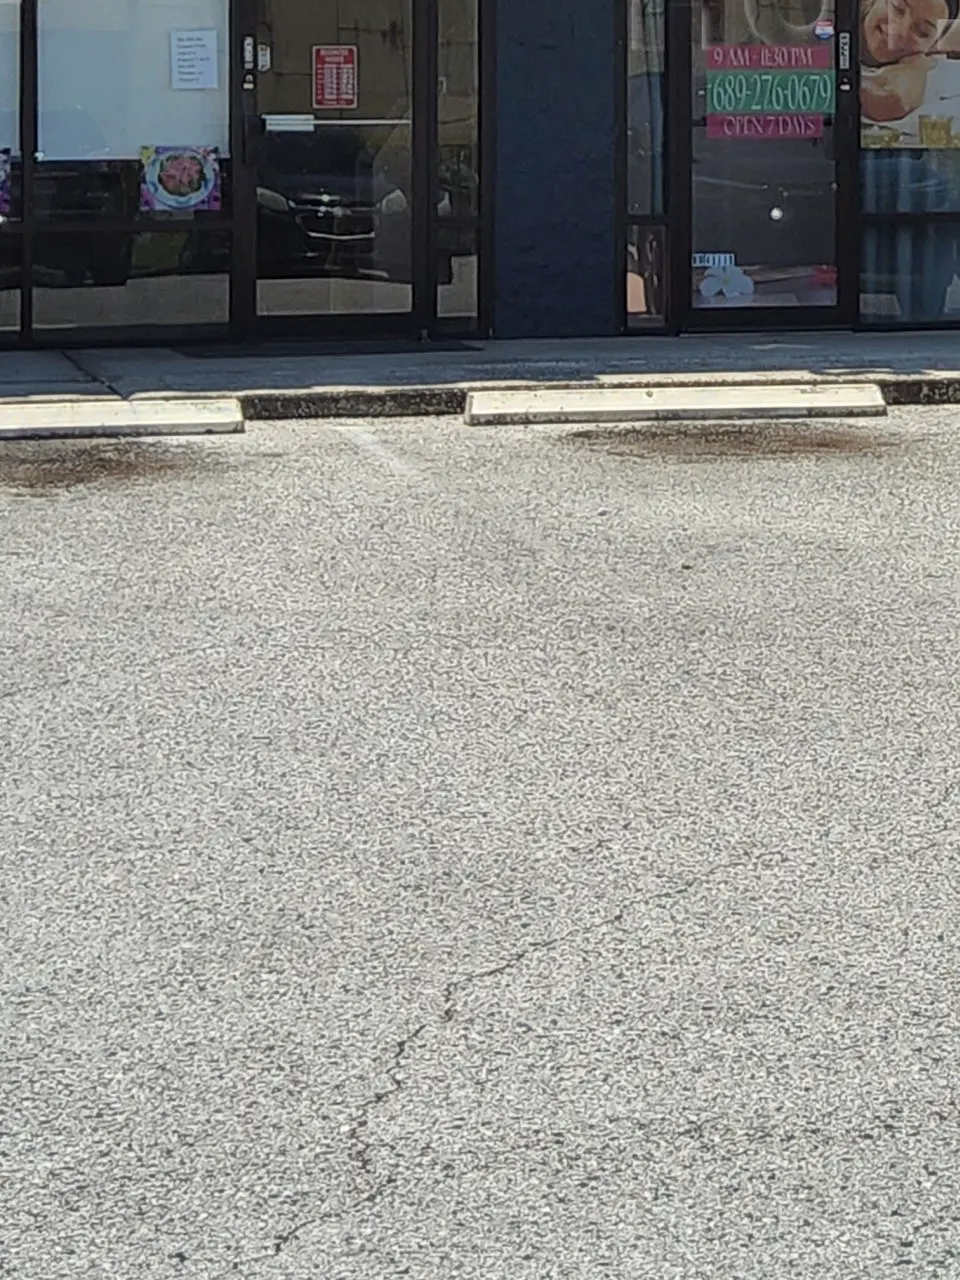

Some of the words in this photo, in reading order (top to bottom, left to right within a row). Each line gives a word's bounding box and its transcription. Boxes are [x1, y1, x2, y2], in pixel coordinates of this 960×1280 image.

[714, 47, 723, 65] 9
[728, 47, 750, 66] AM
[790, 47, 813, 66] PM
[713, 74, 832, 110] 689-276-0679
[724, 116, 764, 135] OPEN
[766, 116, 776, 135] 7
[778, 116, 816, 135] DAYS
